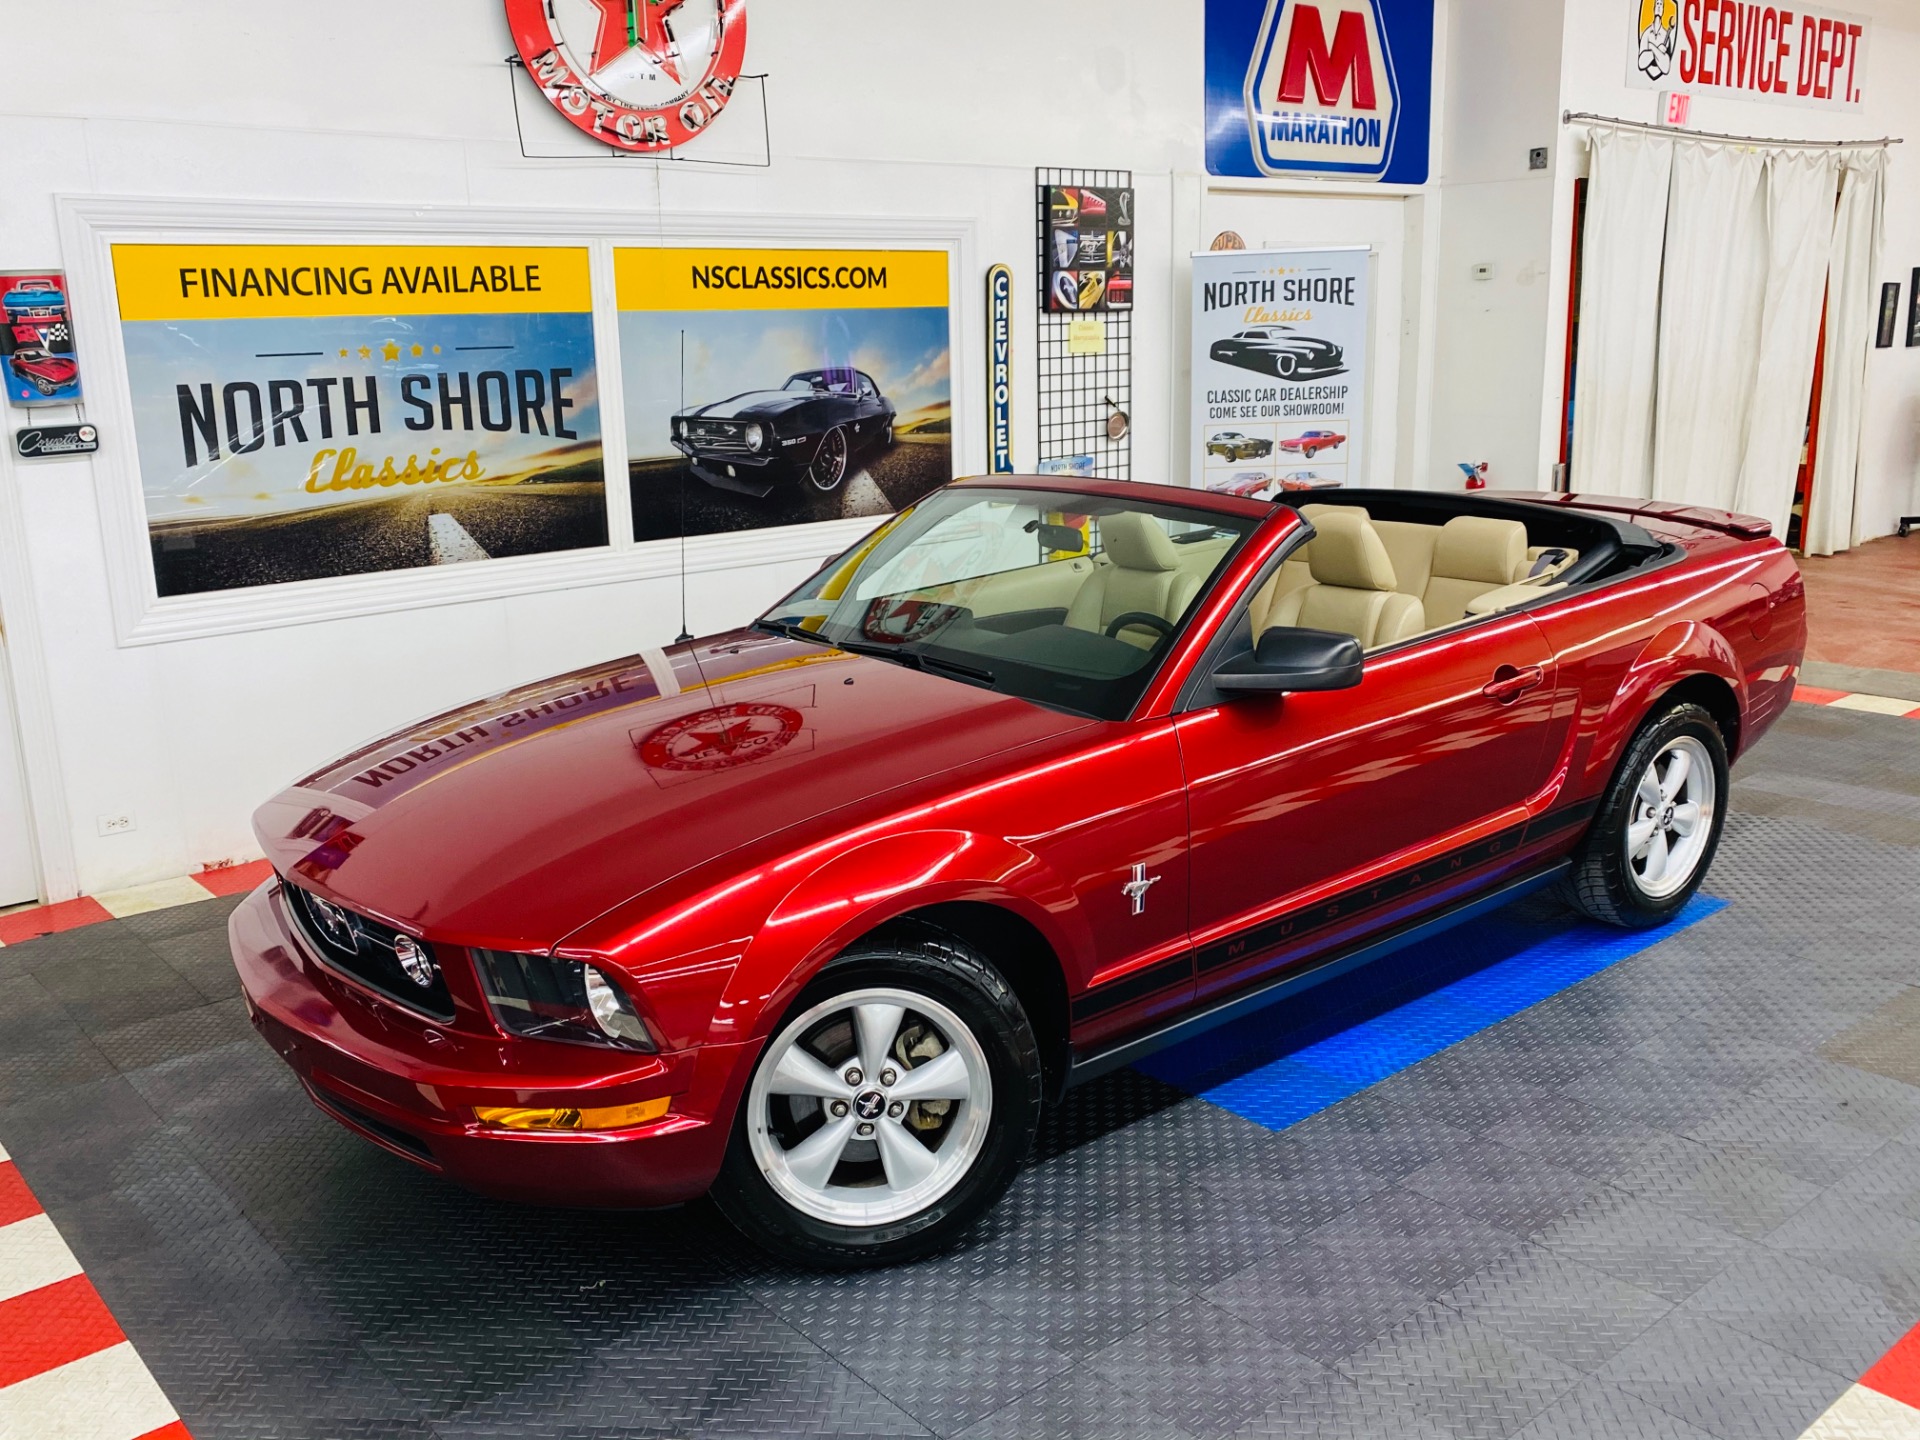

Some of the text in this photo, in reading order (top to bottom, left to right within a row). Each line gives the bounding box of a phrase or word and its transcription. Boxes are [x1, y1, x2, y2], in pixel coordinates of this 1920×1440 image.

[1679, 0, 1863, 104] SERVICE DEPT.
[531, 48, 736, 147] MOTOR OIL
[1667, 92, 1690, 125] EXIT
[1270, 110, 1381, 147] MARATHON
[179, 264, 542, 298] FINANCING AVAILABLE
[691, 265, 888, 289] NSCLASSICS.COM
[1204, 277, 1356, 312] NORTH SHORE
[1243, 306, 1313, 324] Classics
[994, 276, 1009, 469] CHEVROLET
[1207, 385, 1349, 404] CLASSIC CAR DEALERSHIP
[1209, 402, 1345, 419] COME SEE OUR SHOWROOM!
[176, 367, 578, 468] NORTH SHORE
[19, 430, 82, 452] Corvette
[305, 446, 485, 494] Classics
[1228, 841, 1503, 957] MUSTANG
